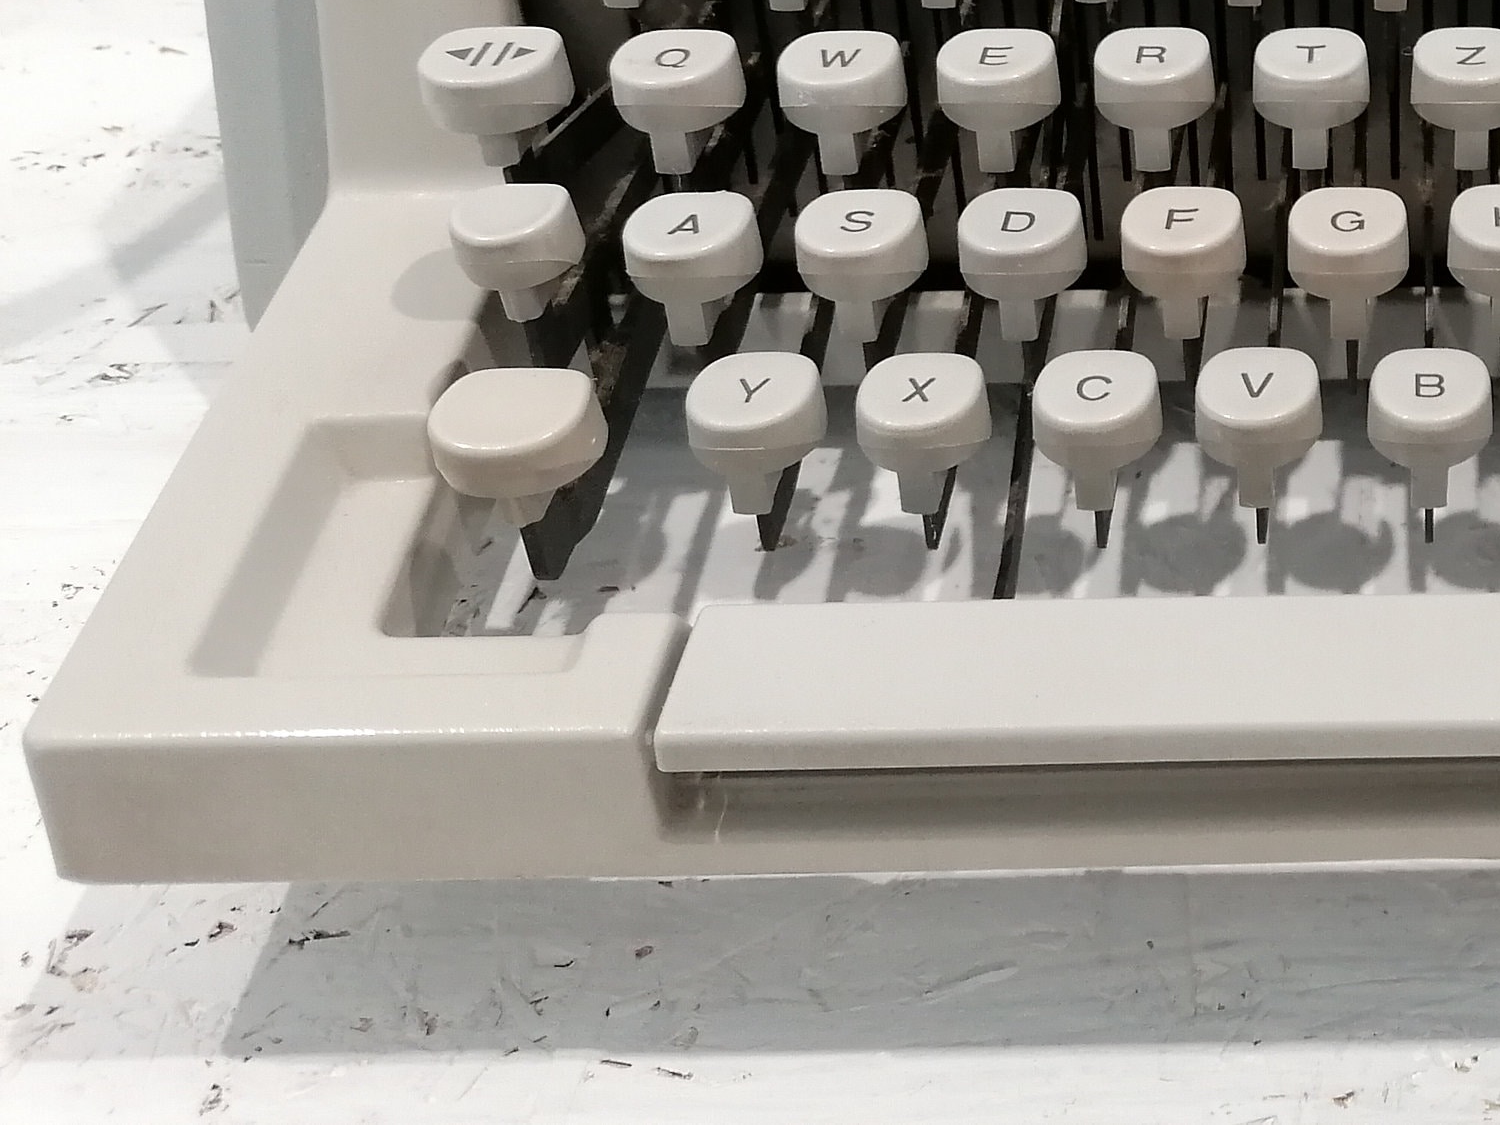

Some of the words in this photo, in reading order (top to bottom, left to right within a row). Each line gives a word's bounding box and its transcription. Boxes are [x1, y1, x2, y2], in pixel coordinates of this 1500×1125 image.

[654, 48, 691, 69] Q
[820, 48, 862, 68] W
[978, 46, 1014, 66] E
[1135, 45, 1167, 64] R
[1295, 44, 1327, 64] T
[1455, 45, 1486, 66] Z
[666, 214, 700, 235] A
[840, 210, 875, 233] S
[1000, 210, 1036, 233] D
[1164, 208, 1200, 230] F
[1330, 210, 1365, 233] G
[739, 377, 771, 404] Y
[901, 377, 936, 403] X
[1076, 375, 1113, 402] C
[1240, 372, 1274, 399] V
[1414, 373, 1446, 398] B
